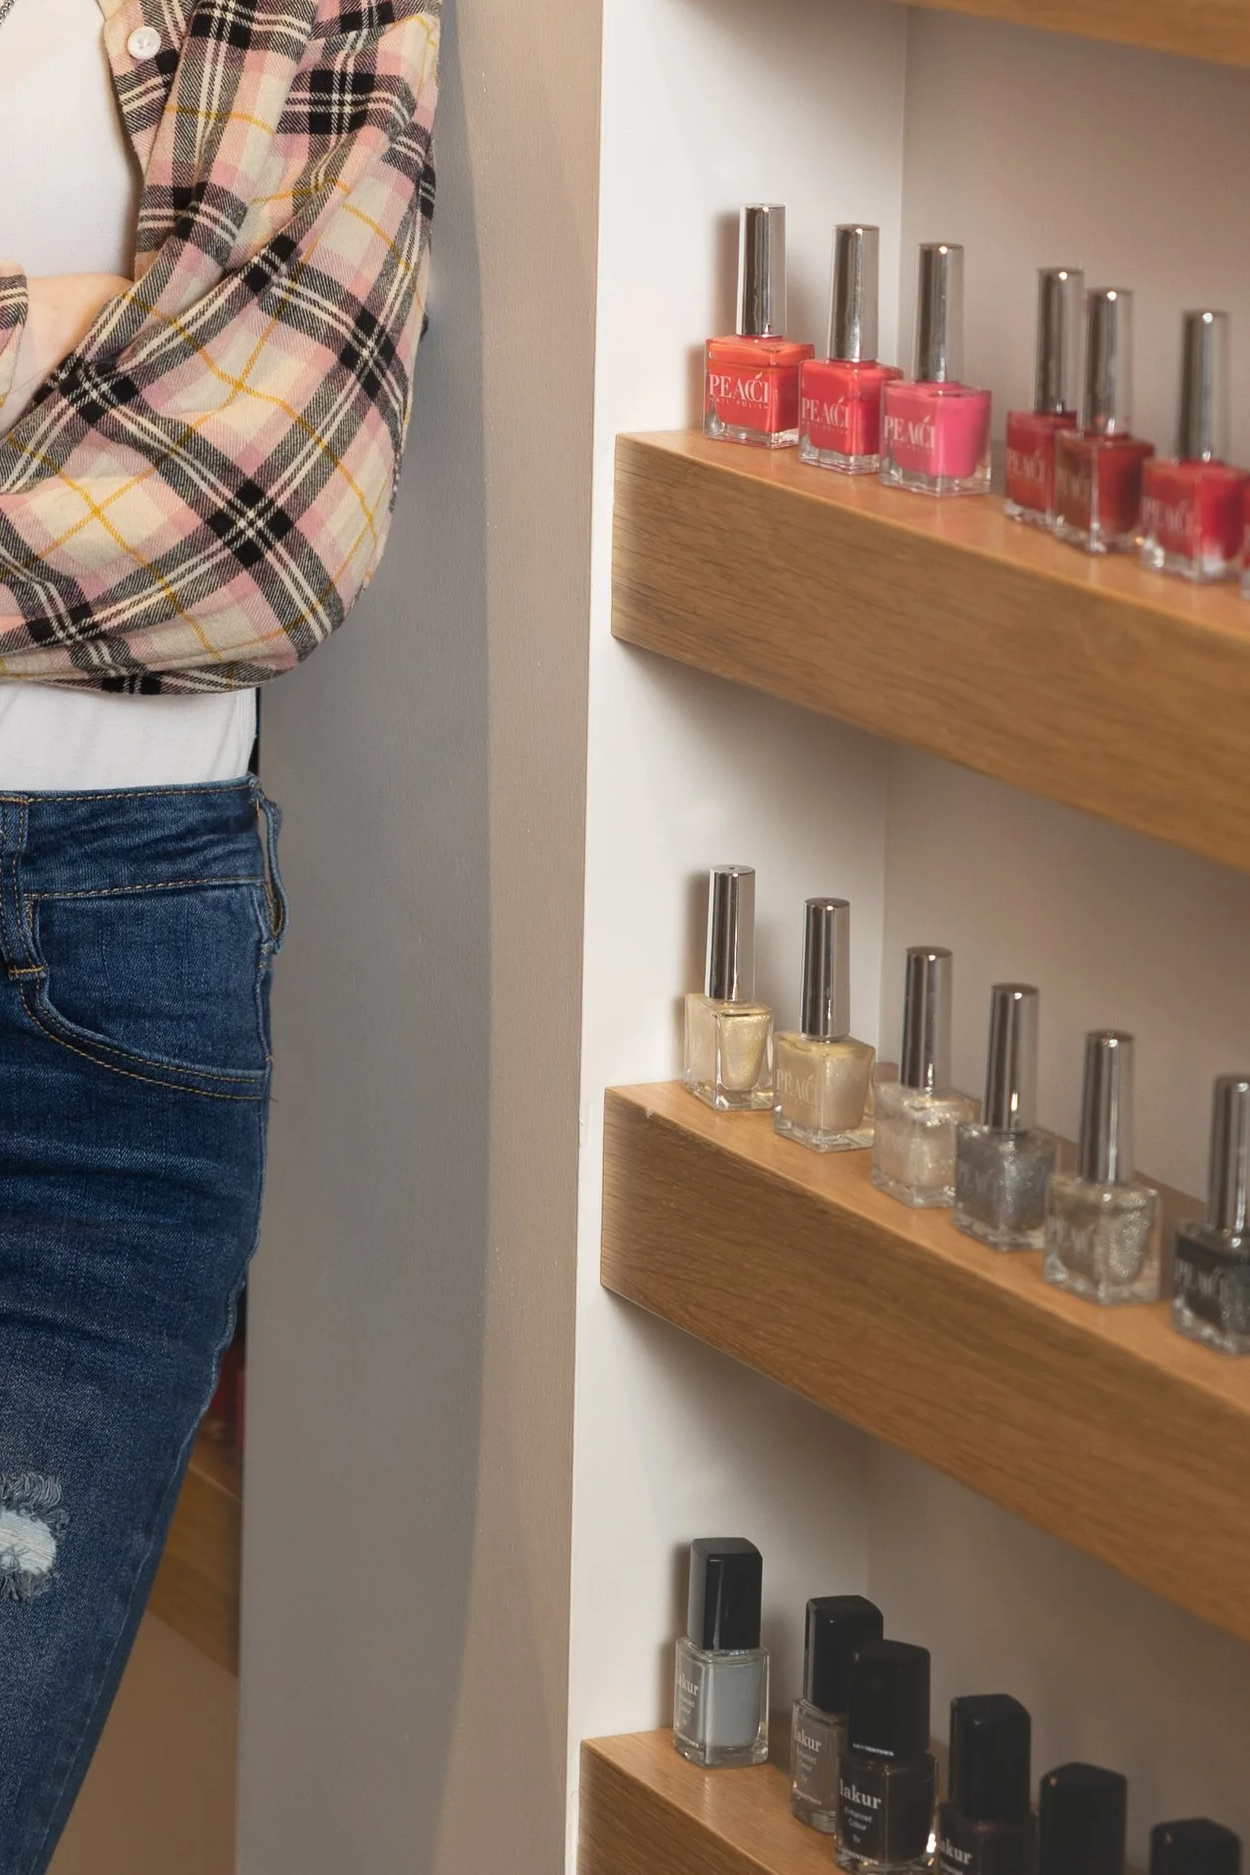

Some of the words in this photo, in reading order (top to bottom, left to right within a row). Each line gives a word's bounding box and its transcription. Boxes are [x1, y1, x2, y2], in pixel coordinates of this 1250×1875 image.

[709, 371, 770, 403] PEACCI
[801, 396, 850, 429] PEACCI
[839, 1778, 882, 1810] lakur
[940, 1837, 973, 1865] akur
